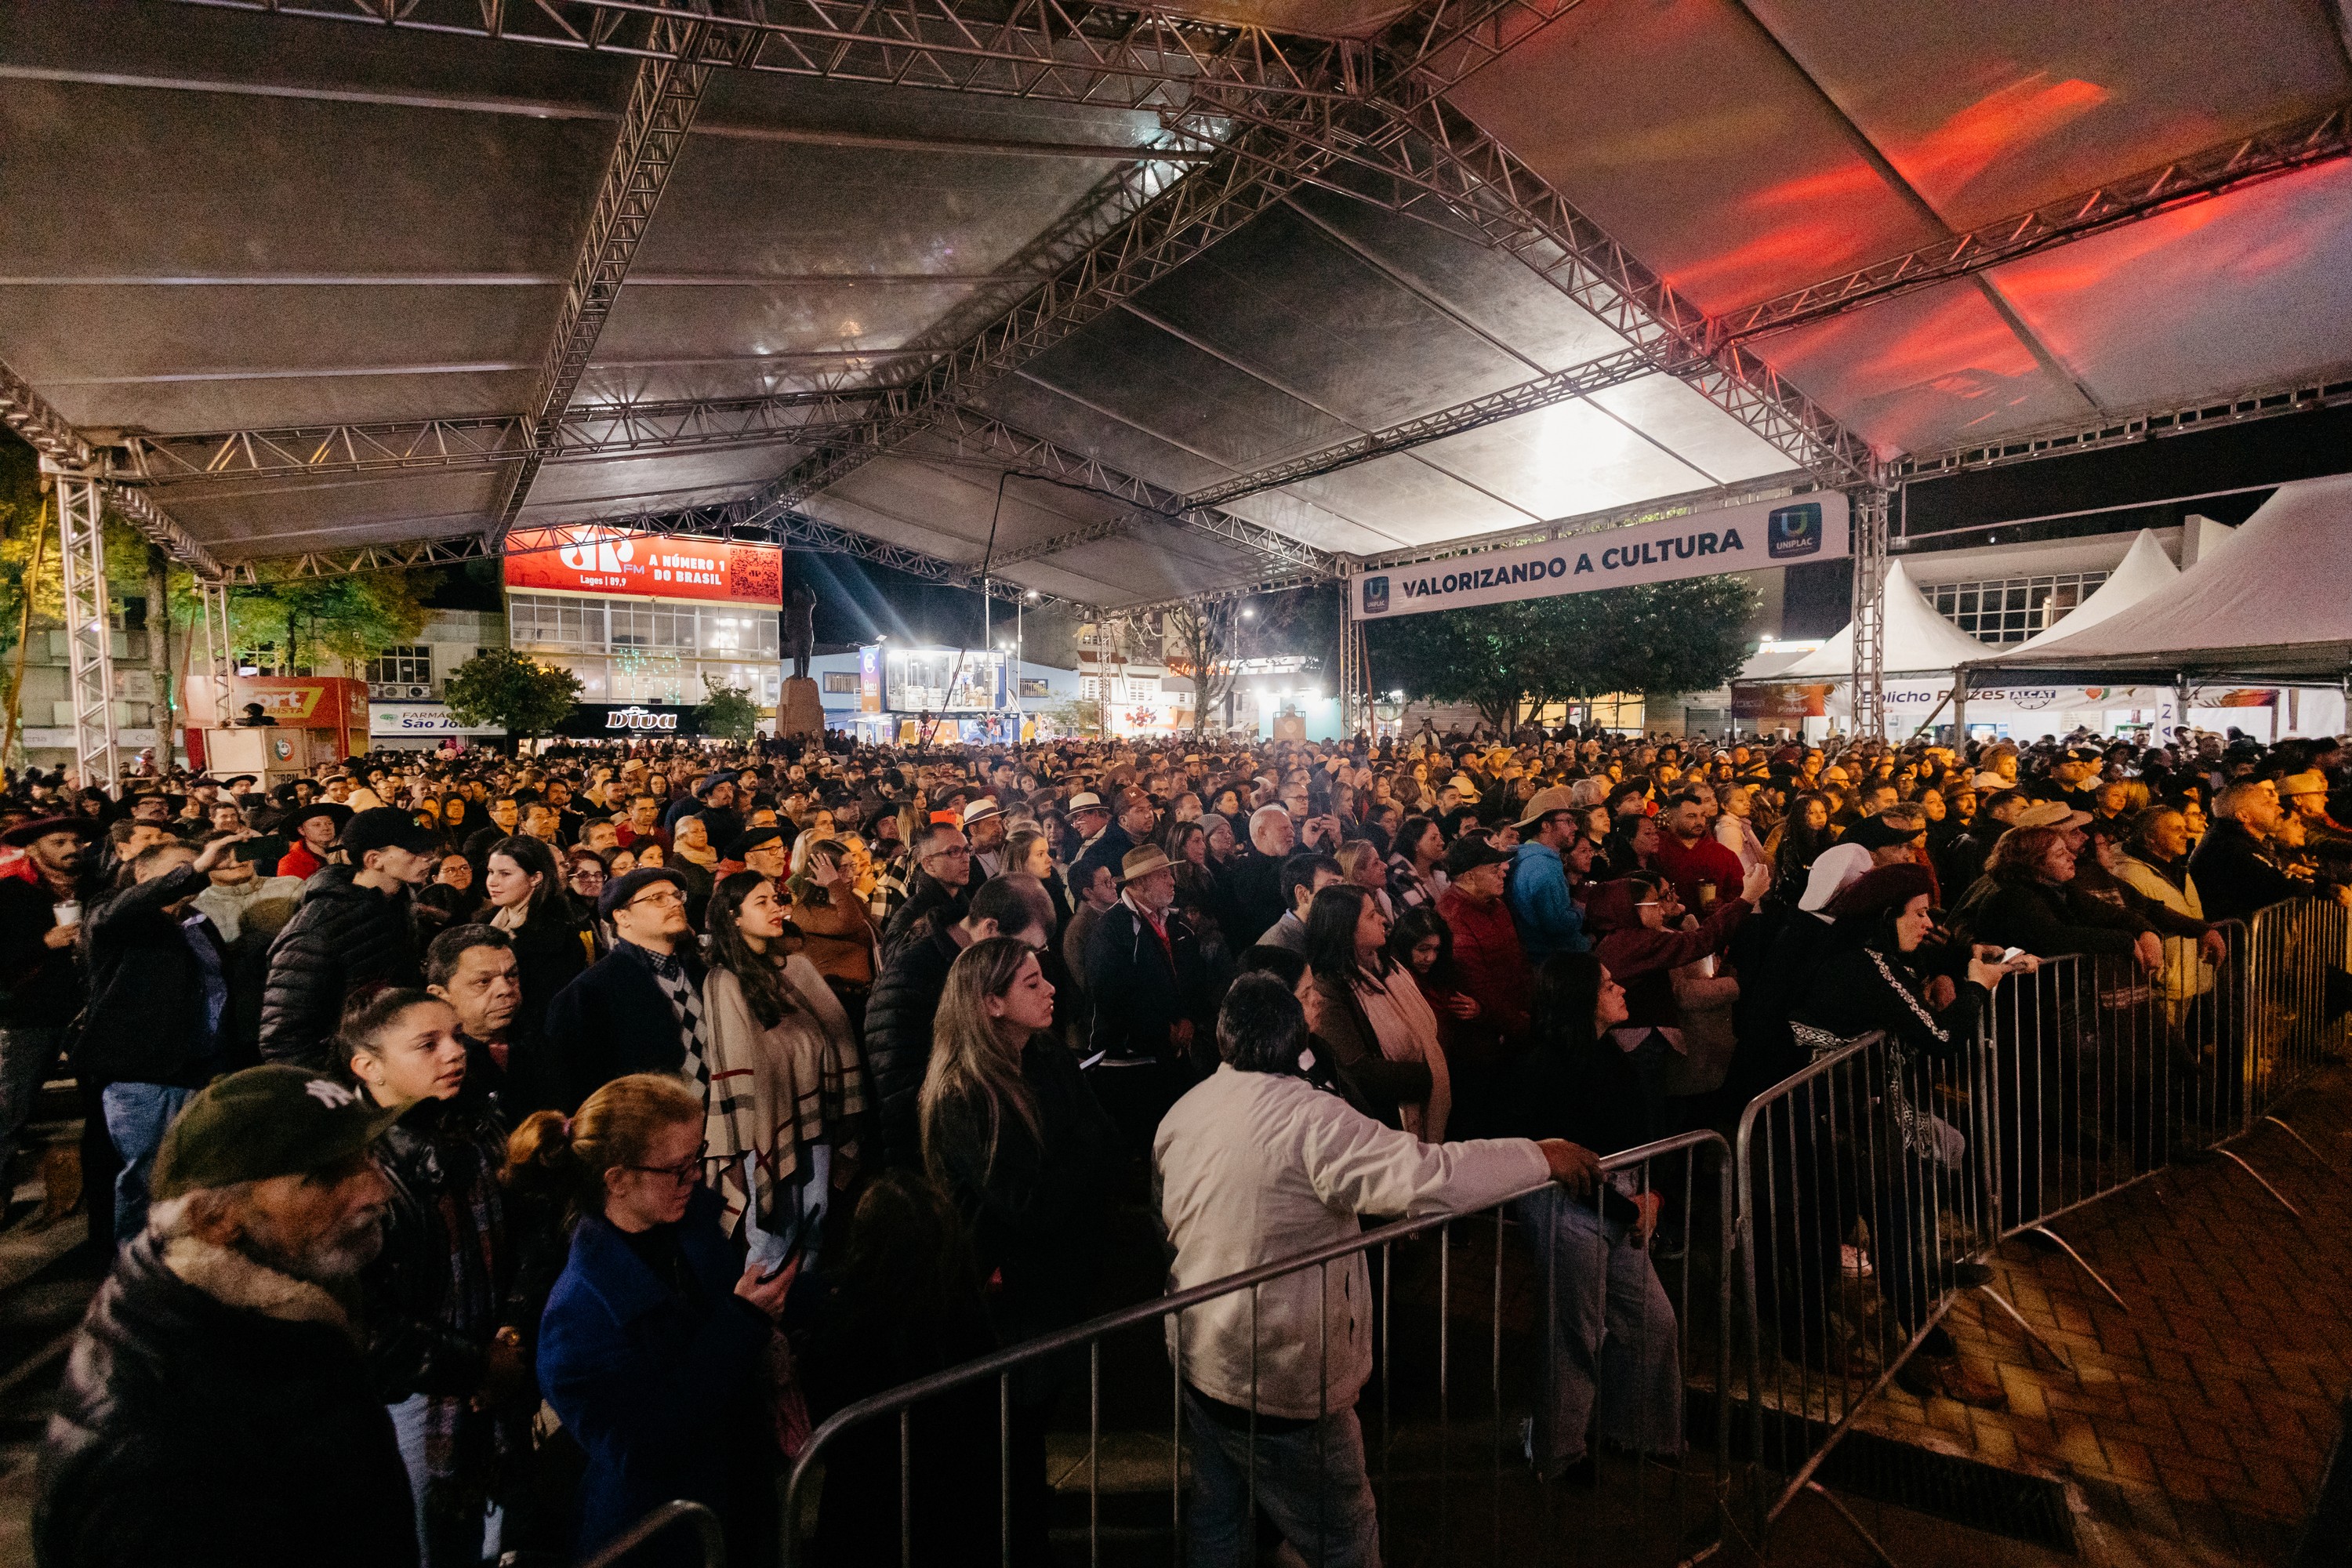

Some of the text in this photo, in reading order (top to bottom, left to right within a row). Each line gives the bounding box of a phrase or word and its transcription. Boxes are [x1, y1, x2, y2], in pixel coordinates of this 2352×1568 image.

[1777, 537, 1813, 550] UNIPLAC
[623, 564, 644, 575] FM
[649, 554, 725, 572] A NÚMERO 1
[1403, 528, 1744, 599] VALORIZANDO A CULTURA
[580, 575, 626, 587] Lages 89,9
[654, 569, 721, 585] DO BRASIL
[248, 691, 302, 708] ort
[2013, 690, 2055, 699] ALCAT
[402, 718, 434, 728] São
[605, 706, 677, 729] Diva
